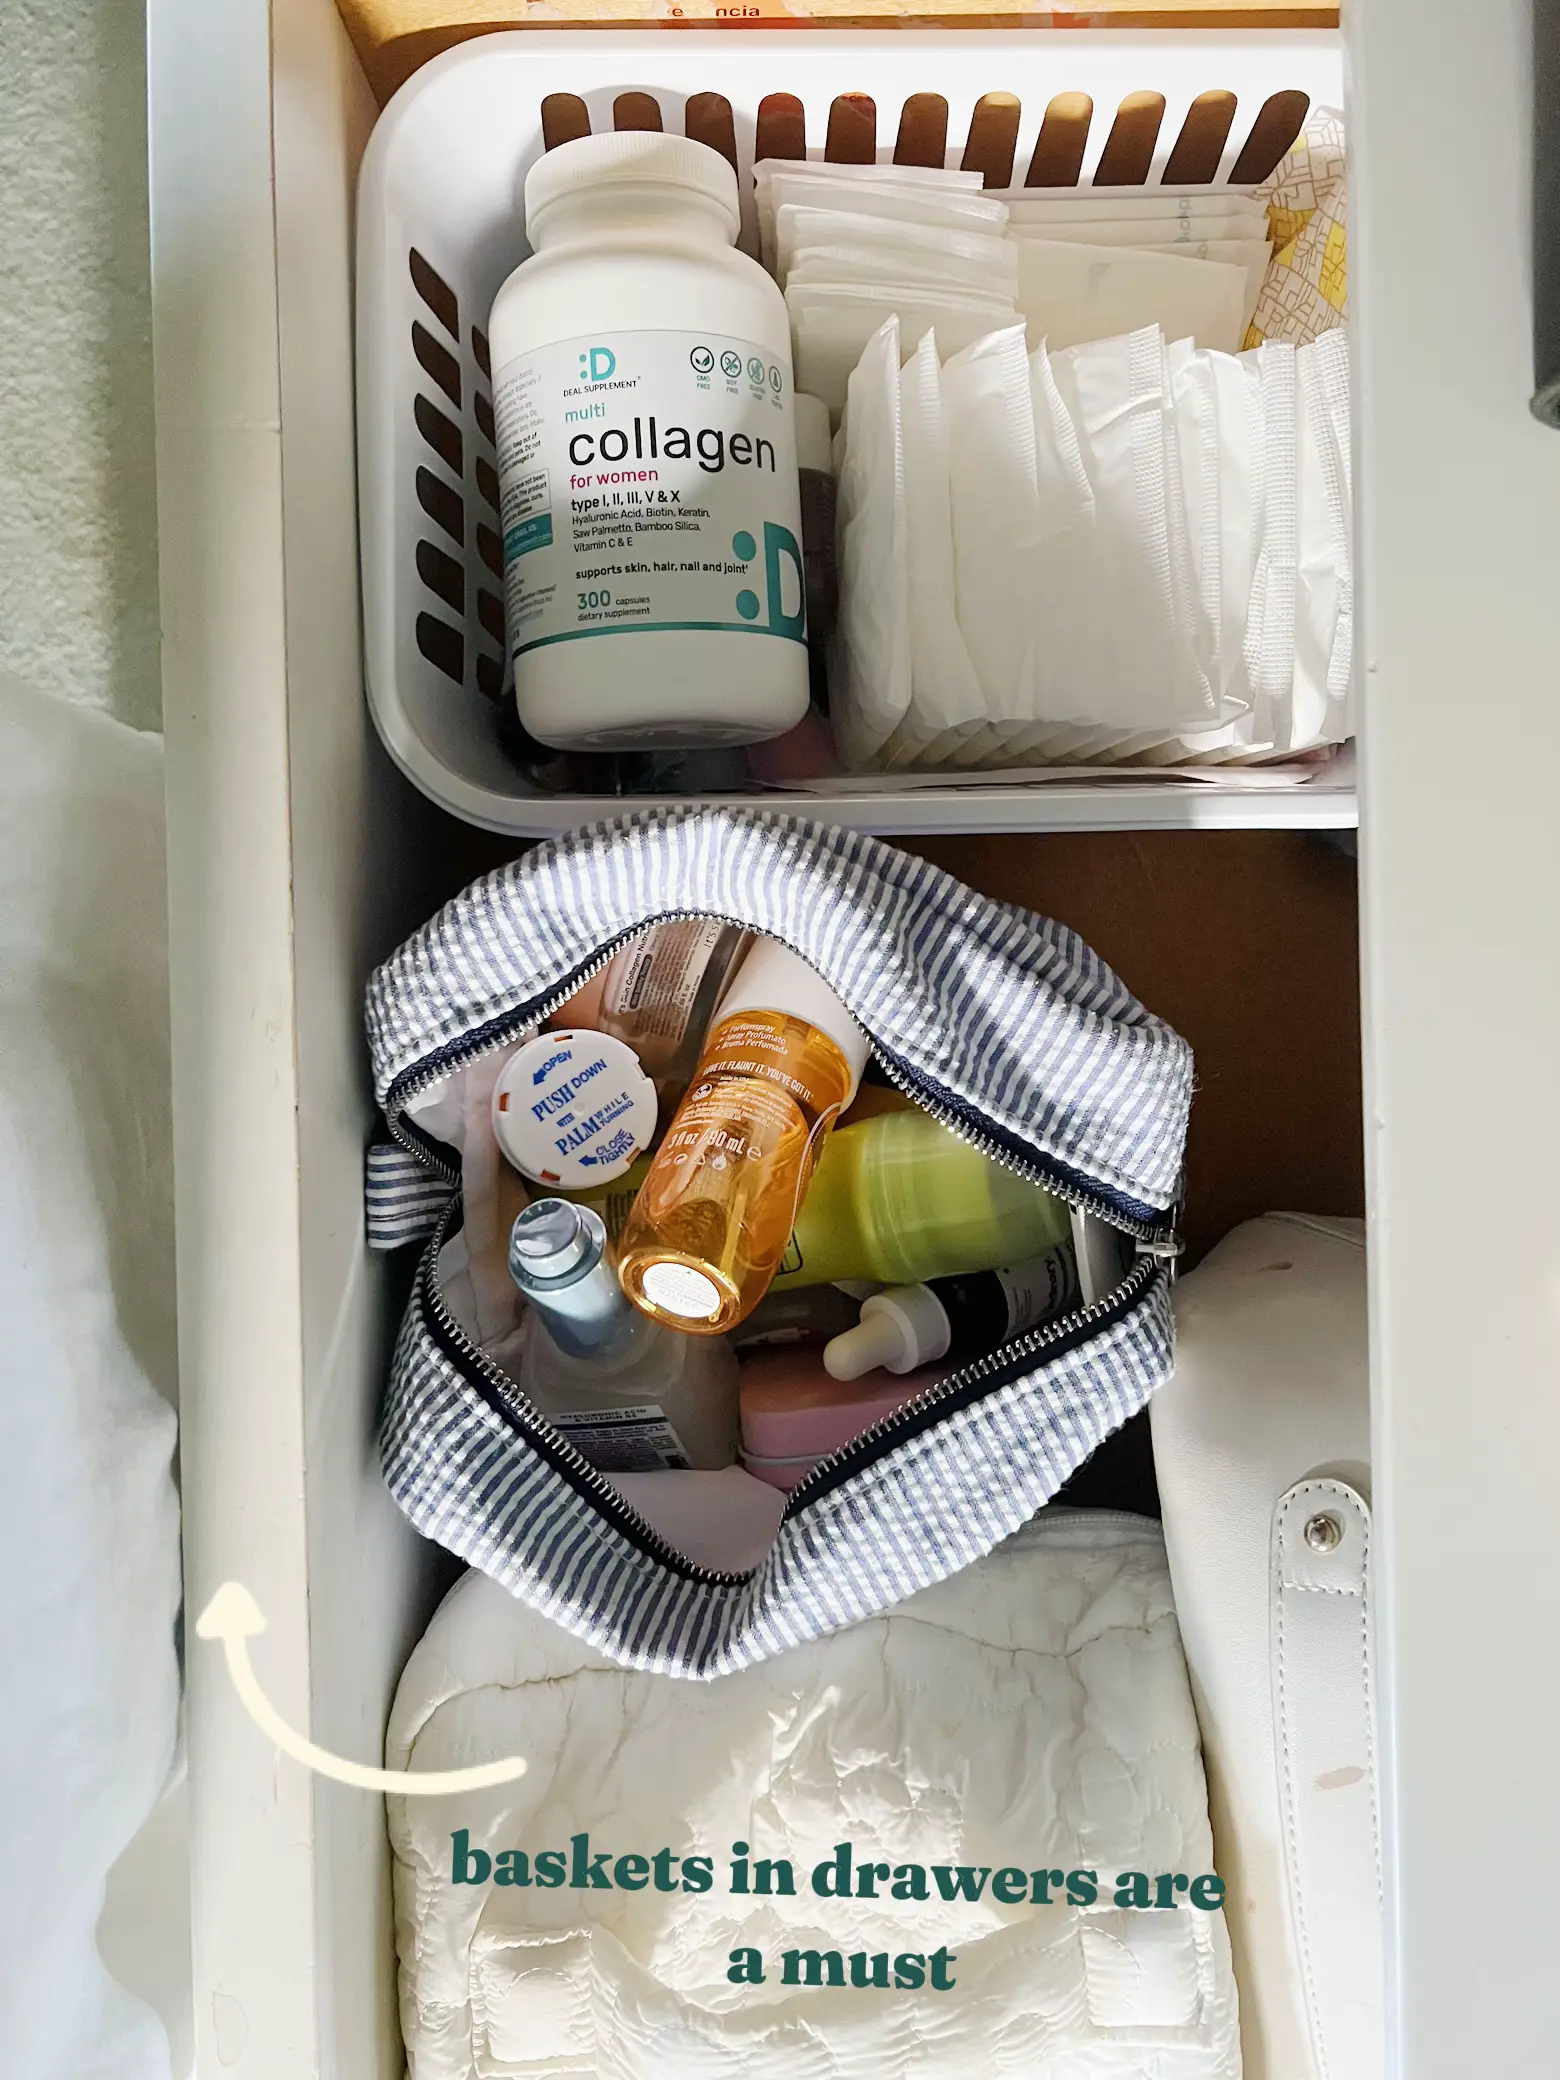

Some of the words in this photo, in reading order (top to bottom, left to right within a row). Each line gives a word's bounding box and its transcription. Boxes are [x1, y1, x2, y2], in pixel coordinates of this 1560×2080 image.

[563, 386, 582, 397] DEAL
[584, 379, 638, 394] SUPPLEMENT
[565, 402, 606, 423] multi
[569, 416, 776, 473] collagen
[569, 475, 592, 490] for
[597, 470, 659, 486] women
[571, 496, 600, 513] type
[645, 490, 655, 504] V
[657, 490, 668, 503] &
[670, 490, 681, 503] X
[572, 510, 619, 526] Hyaluronic
[646, 507, 676, 519] Biotin,
[678, 507, 711, 519] Keratin,
[573, 529, 590, 539] Saw
[635, 522, 673, 532] Bamboo
[574, 542, 607, 553] Vitamin
[608, 539, 616, 548] C
[618, 538, 625, 548] &
[626, 537, 633, 547] E
[575, 564, 622, 580] supports
[625, 562, 651, 573] skin,
[653, 561, 678, 572] hair,
[680, 561, 700, 571] nail
[703, 561, 722, 572] and
[577, 589, 611, 610] 300
[615, 595, 651, 606] capsules
[577, 611, 603, 622] dietary
[604, 606, 651, 620] supplement
[626, 952, 642, 986] Collagen
[746, 1030, 787, 1045] Profumato
[746, 1039, 788, 1056] Perfumada
[543, 1050, 573, 1072] OPEN
[727, 1060, 755, 1071] FLAUNT
[755, 1063, 766, 1074] IT.
[766, 1066, 792, 1085] YOU'VE
[790, 1077, 805, 1094] GOT
[531, 1084, 576, 1122] PUSH
[571, 1059, 608, 1089] DOWN
[556, 1112, 576, 1128] WITH
[554, 1115, 602, 1156] PALM
[596, 1128, 628, 1156] CLOSE
[668, 1133, 676, 1149] 3
[684, 1132, 700, 1145] oz
[708, 1130, 728, 1148] 90
[726, 1135, 747, 1155] mL
[597, 1132, 636, 1165] TIGHTLY
